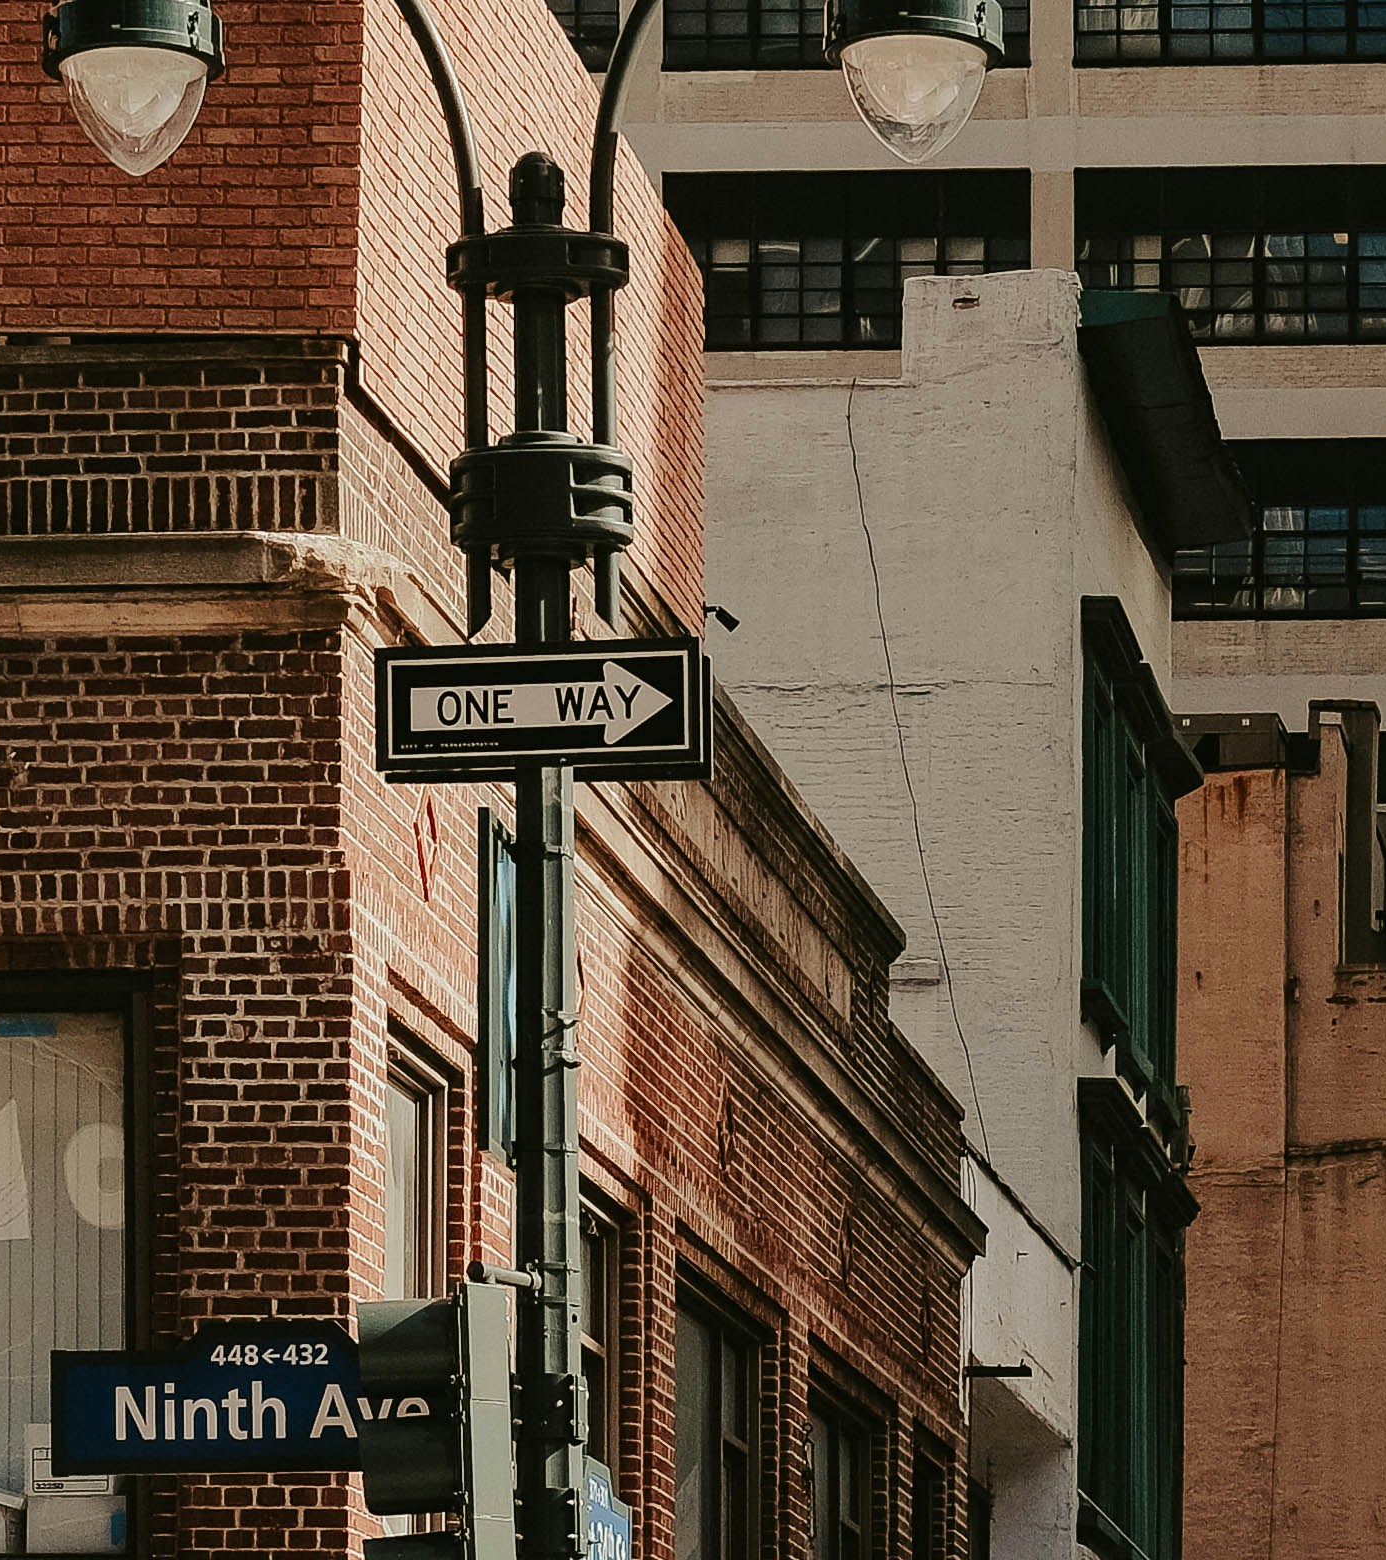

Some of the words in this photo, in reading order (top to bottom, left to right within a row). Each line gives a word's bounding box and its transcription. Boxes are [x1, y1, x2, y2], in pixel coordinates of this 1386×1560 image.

[436, 688, 515, 726] ONE
[555, 684, 642, 722] WAY
[210, 1343, 258, 1367] 448
[281, 1343, 330, 1366] 432
[114, 1380, 287, 1441] Ninth
